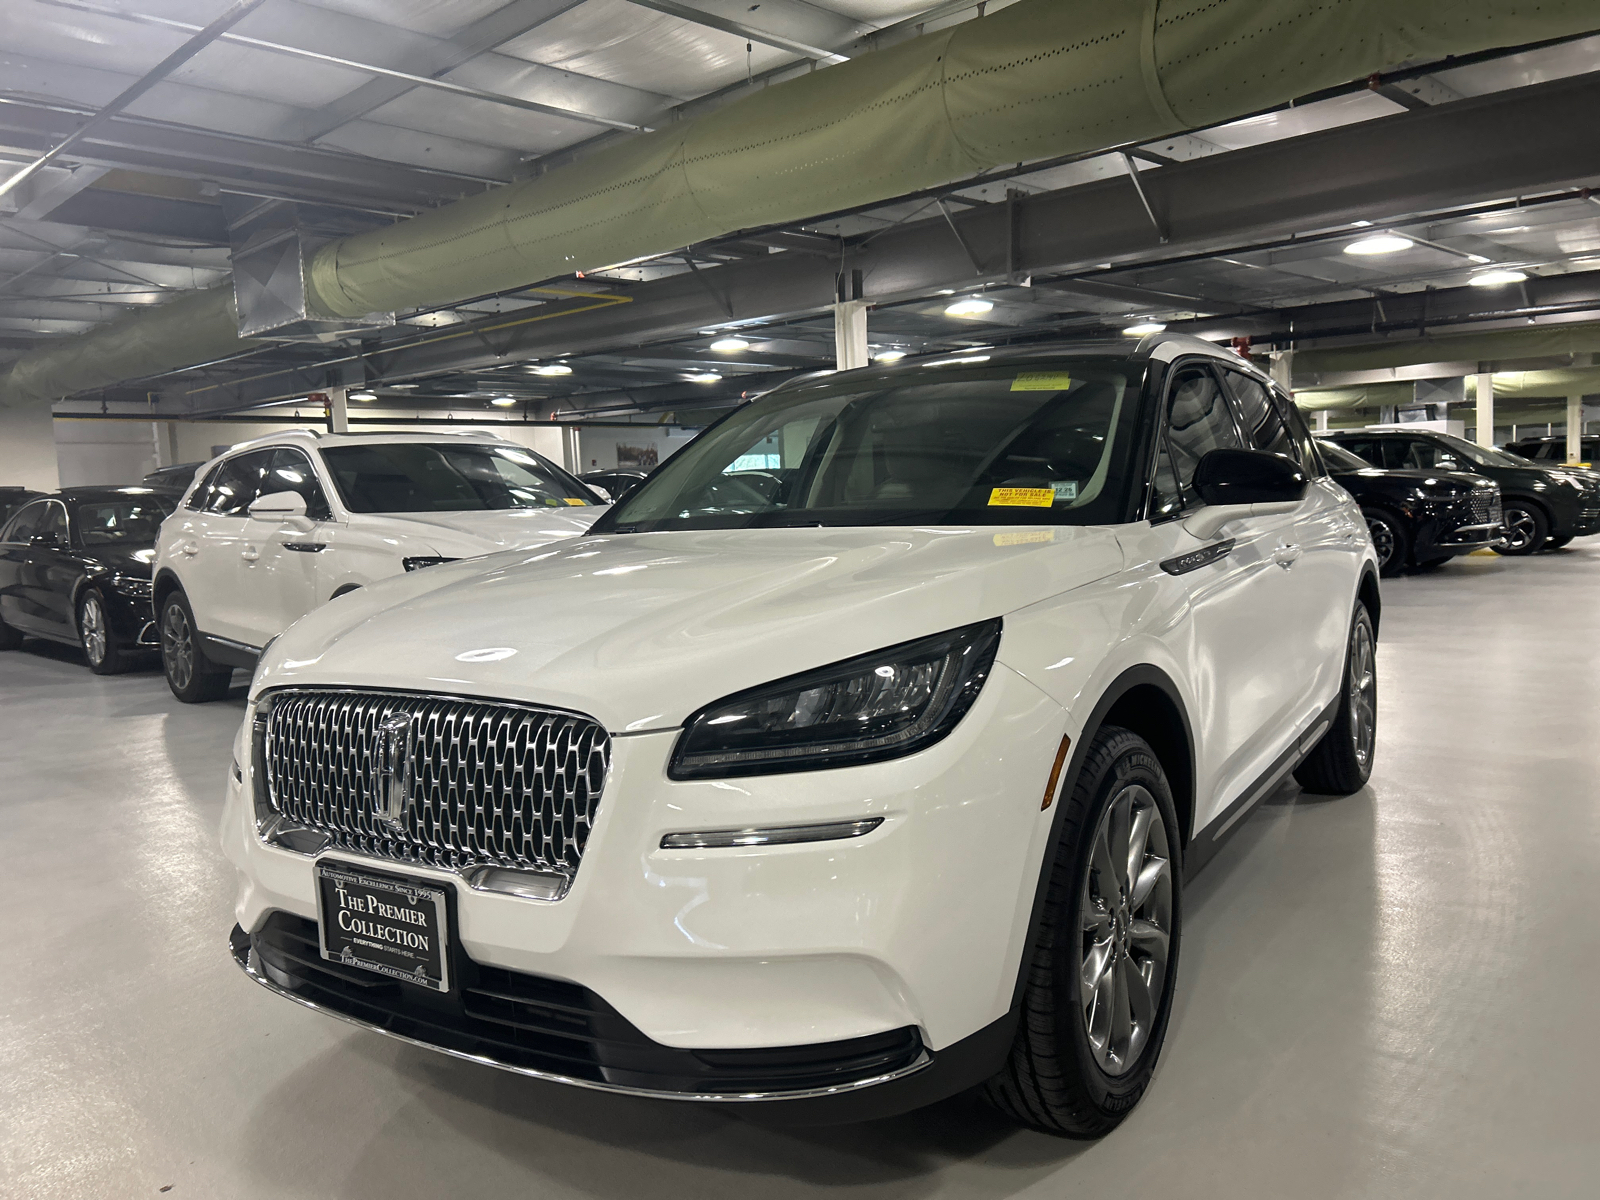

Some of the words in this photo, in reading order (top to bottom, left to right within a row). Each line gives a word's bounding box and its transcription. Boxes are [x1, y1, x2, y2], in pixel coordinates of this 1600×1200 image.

[1131, 754, 1162, 778] MICHELIN
[414, 888, 432, 899] 1995
[335, 888, 366, 913] THE
[366, 894, 428, 927] PREMIER
[338, 909, 429, 951] COLLECTION
[353, 937, 384, 950] EVERYTHING
[383, 945, 401, 955] STARTS
